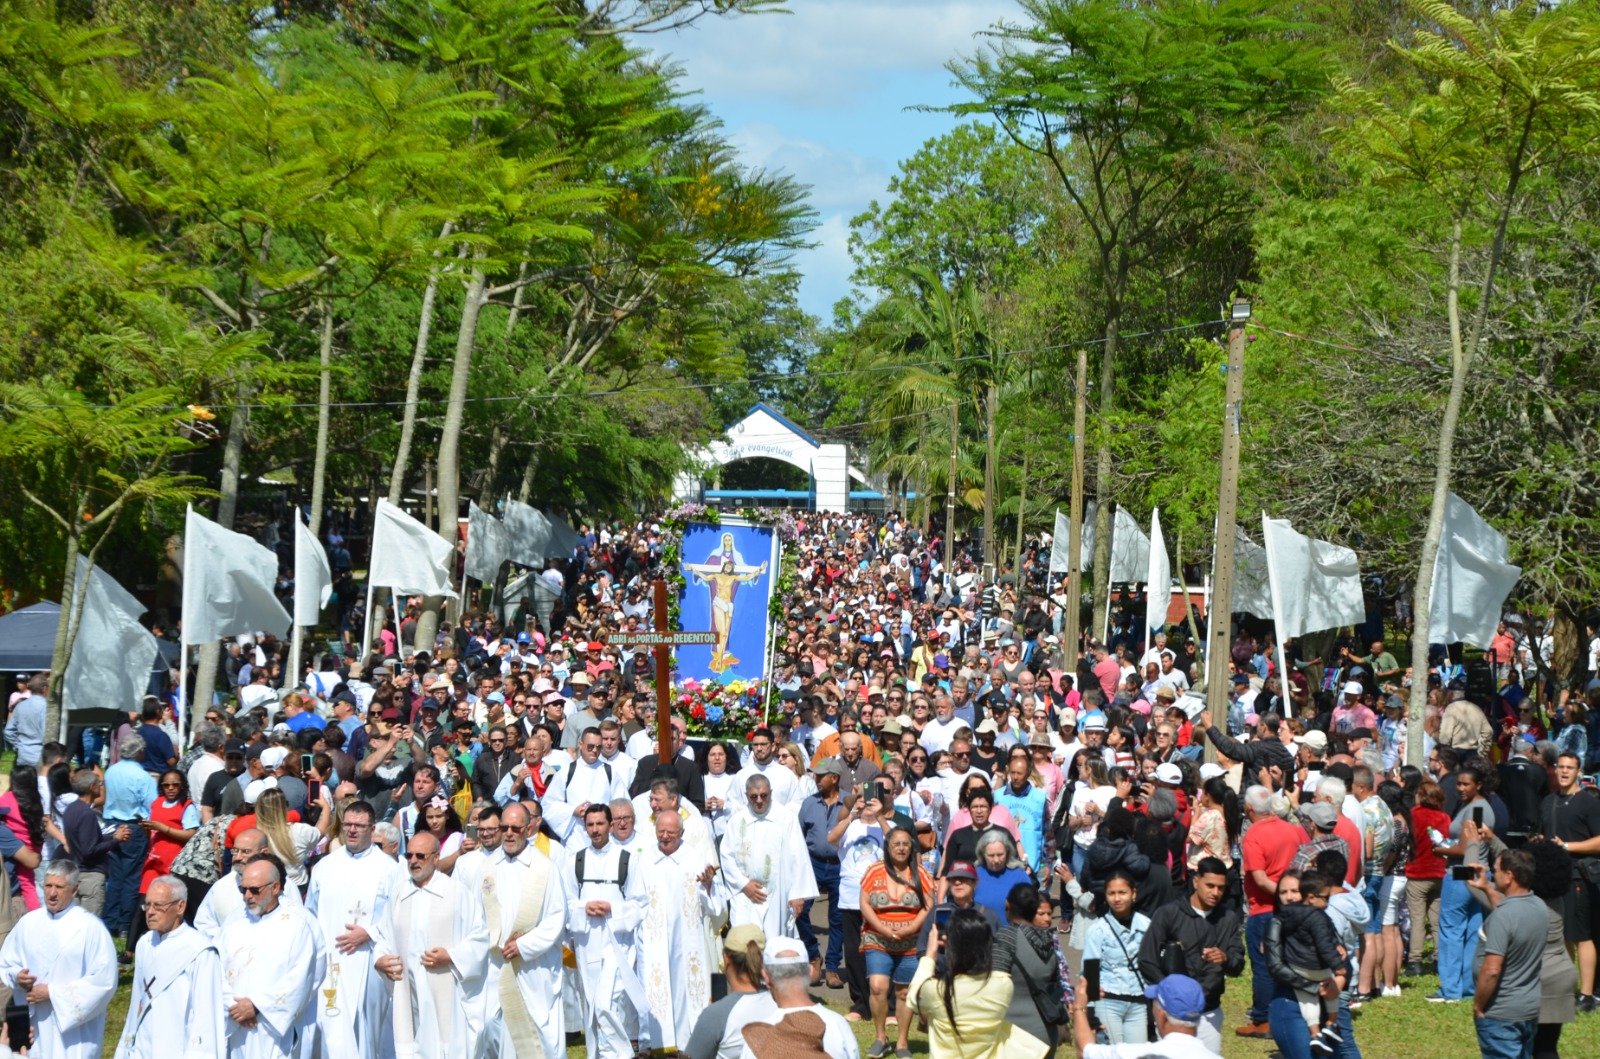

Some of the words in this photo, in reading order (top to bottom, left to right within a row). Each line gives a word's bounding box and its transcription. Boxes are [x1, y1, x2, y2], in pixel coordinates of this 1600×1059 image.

[608, 634, 626, 644] ABRI
[636, 634, 663, 644] PORTAS
[673, 633, 716, 643] REDENTOR
